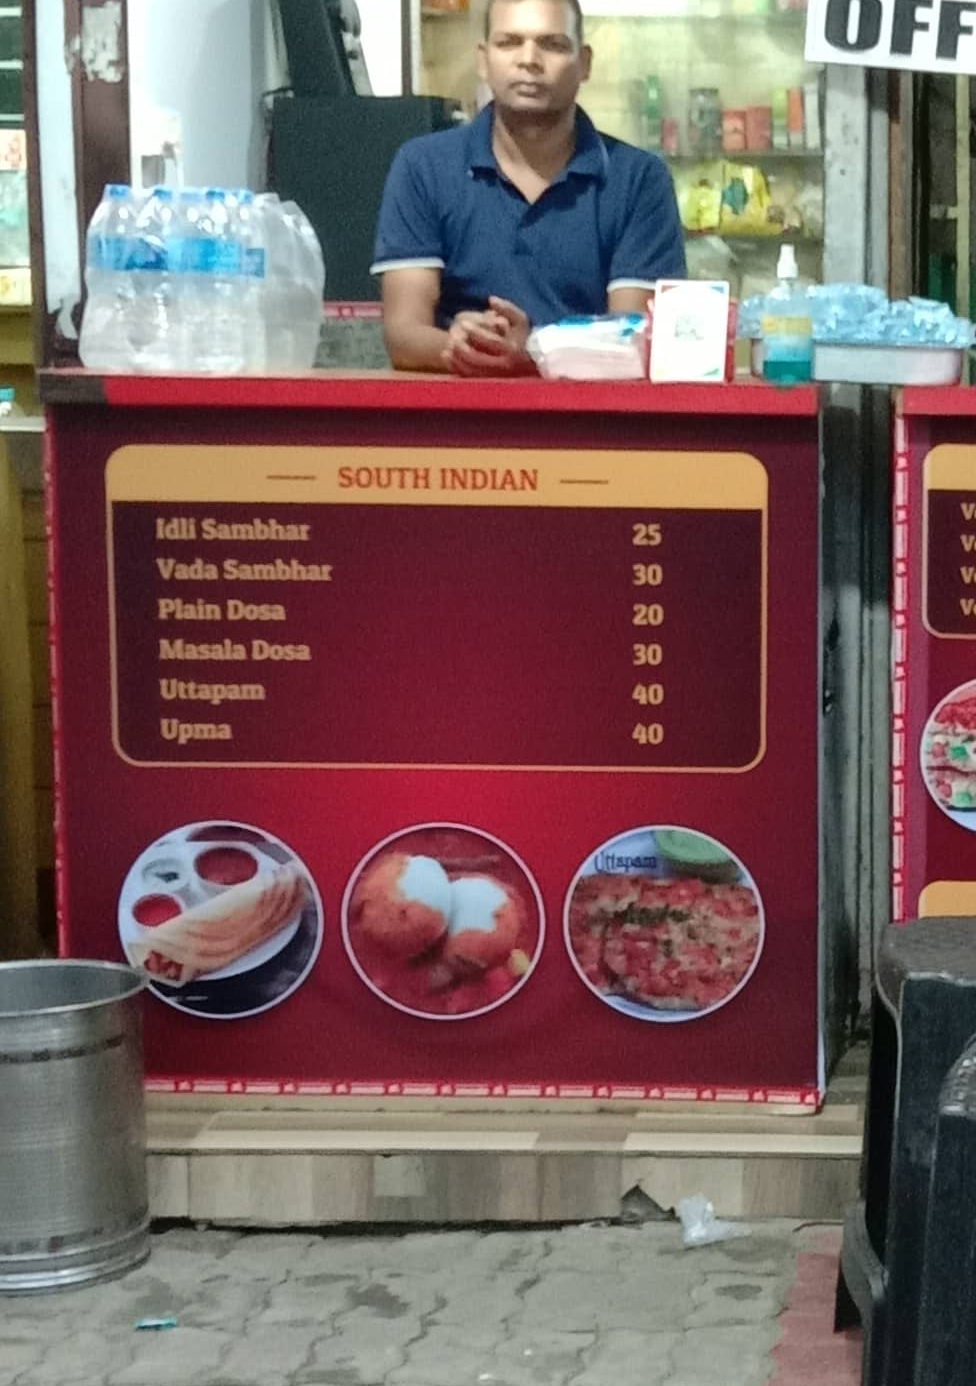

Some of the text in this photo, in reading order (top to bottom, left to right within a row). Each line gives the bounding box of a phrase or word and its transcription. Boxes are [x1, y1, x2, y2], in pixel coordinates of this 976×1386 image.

[337, 466, 539, 492] SOUTH INDIAN
[156, 518, 662, 546] Idli Sambhar 25
[156, 559, 663, 586] Vada Sambhar 30
[158, 599, 664, 626] Plain Dosa 20
[159, 639, 663, 666] Masala Dosa 30
[159, 679, 664, 705] Uttapam 40
[160, 719, 664, 745] Upma 40
